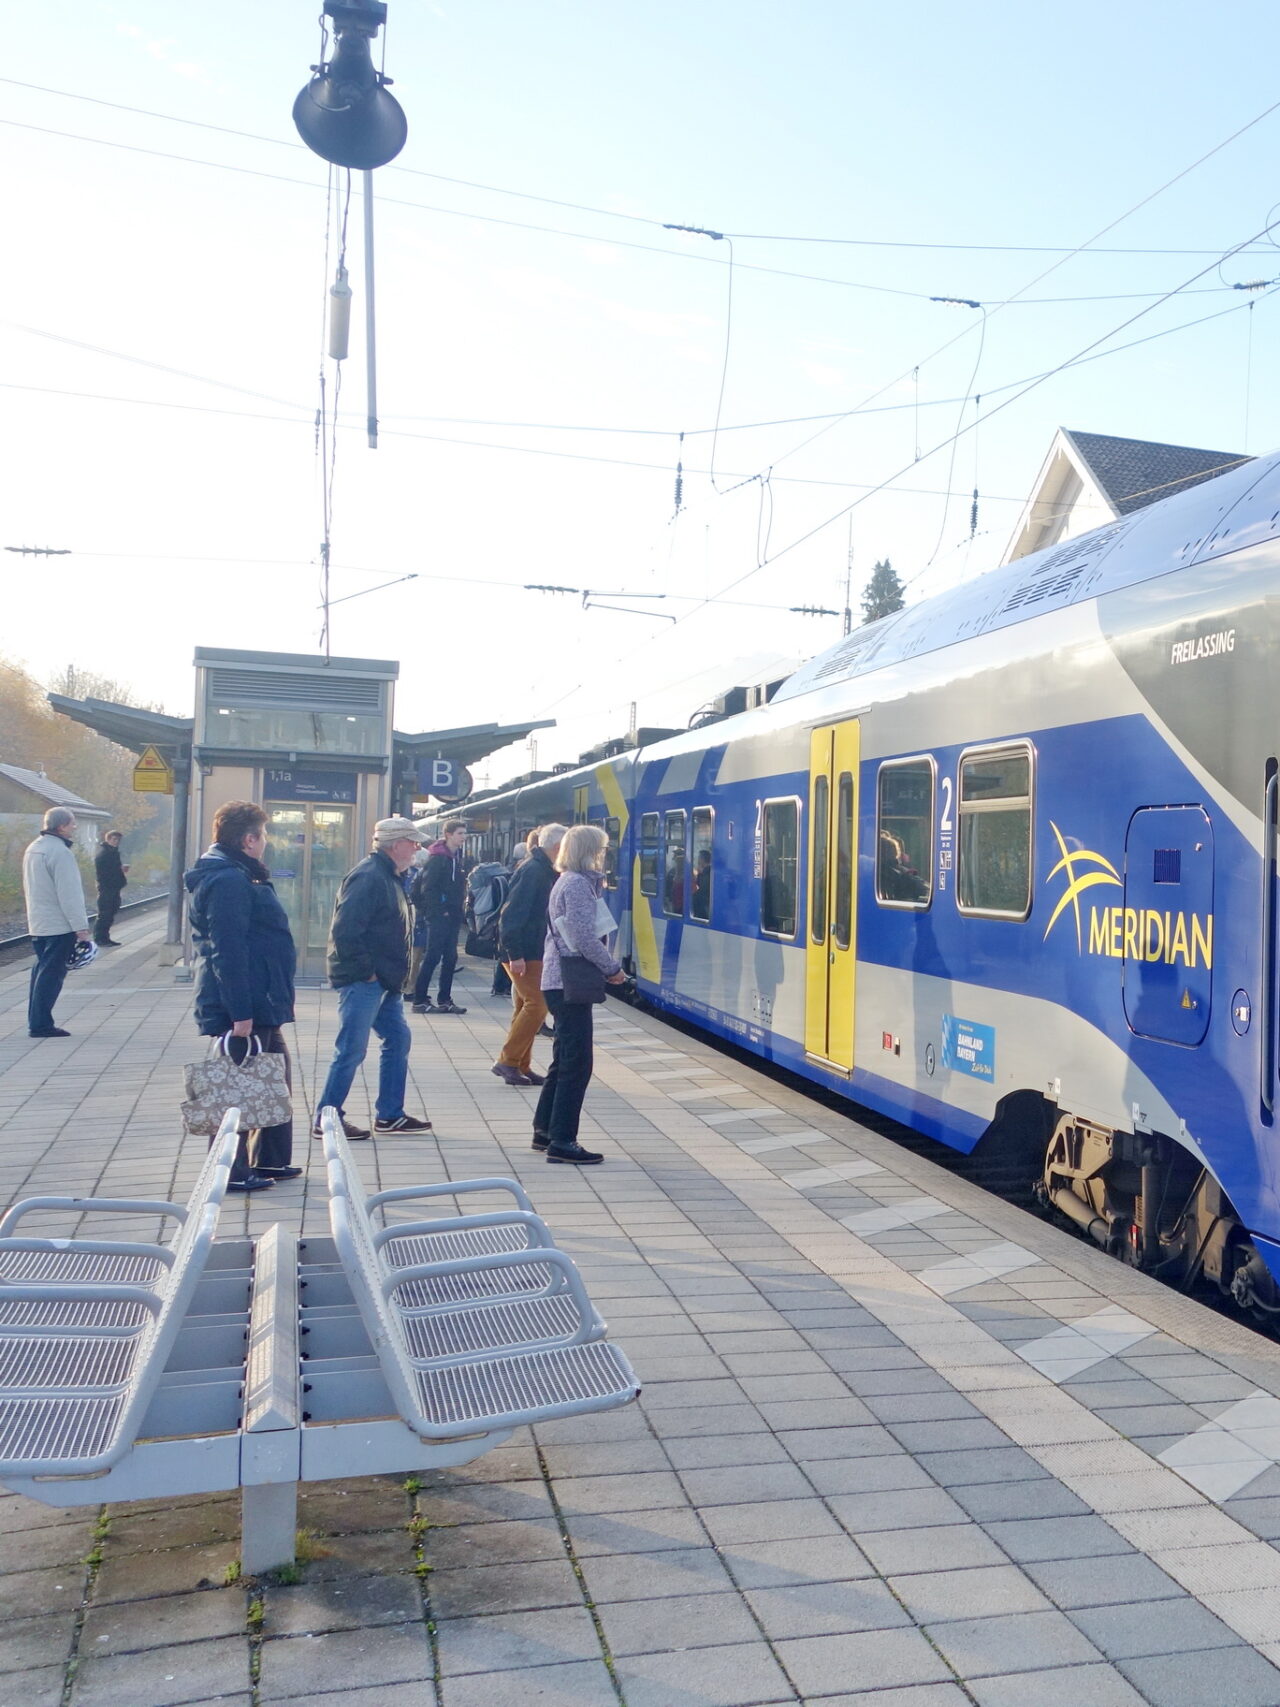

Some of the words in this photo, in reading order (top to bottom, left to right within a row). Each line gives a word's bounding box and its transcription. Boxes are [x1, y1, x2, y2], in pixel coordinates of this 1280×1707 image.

[1171, 629, 1236, 665] FREILASSING
[269, 770, 292, 782] 1,1a
[432, 759, 453, 787] B
[755, 799, 762, 837] 2
[941, 777, 952, 831] 2
[1089, 906, 1213, 970] MERIDIAN
